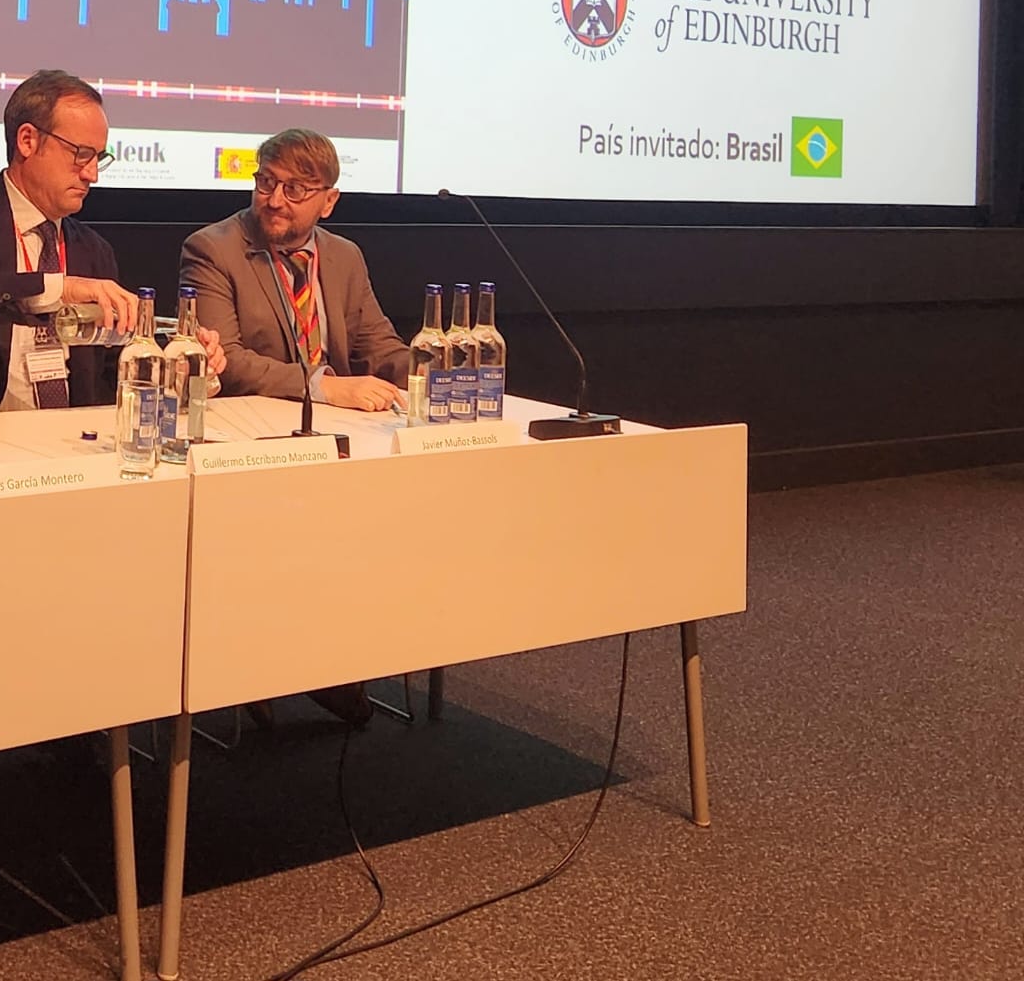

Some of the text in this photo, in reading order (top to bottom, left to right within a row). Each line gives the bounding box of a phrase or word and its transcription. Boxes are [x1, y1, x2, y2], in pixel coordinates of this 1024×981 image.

[655, 5, 840, 54] of EDINBURGH
[579, 123, 783, 162] País invitado: Brasil
[422, 441, 444, 451] Javier
[202, 452, 328, 469] Guillermo Escribano Manzano
[7, 476, 39, 490] García
[40, 473, 85, 487] Montero
